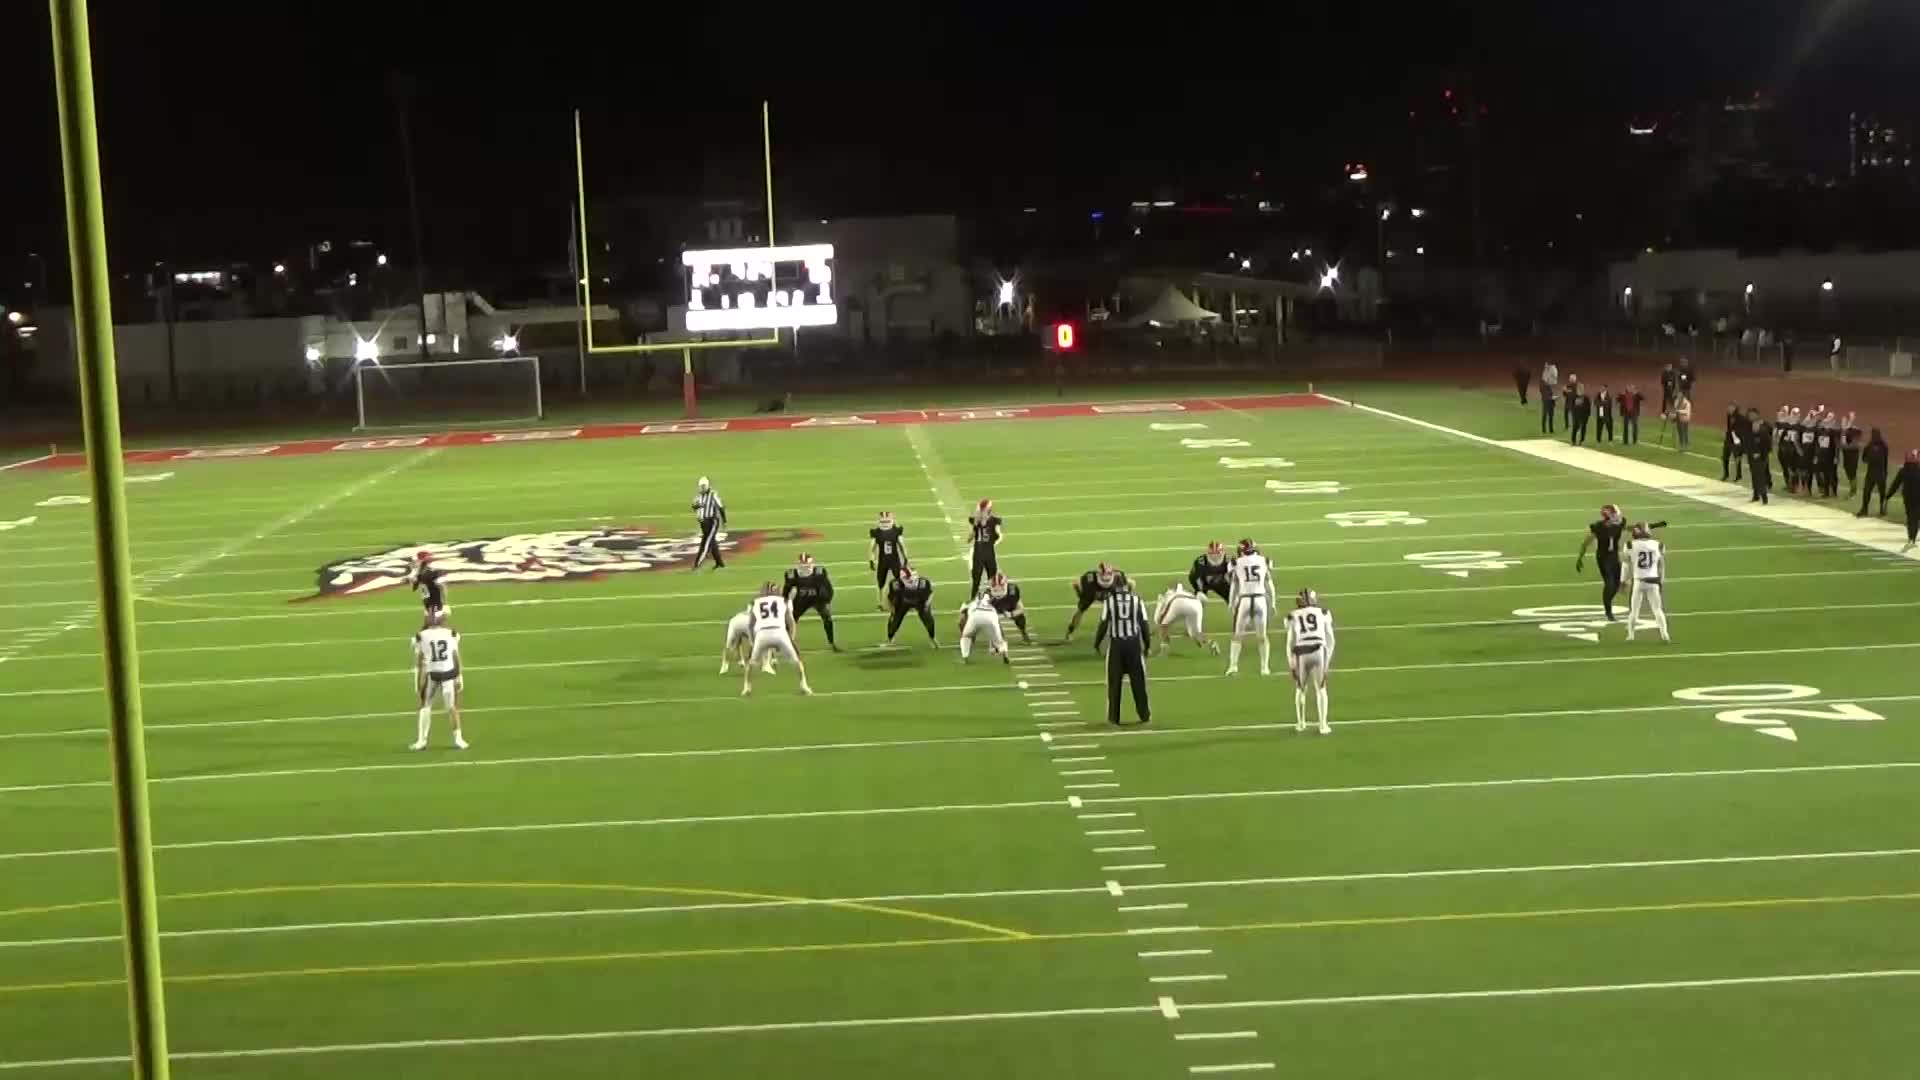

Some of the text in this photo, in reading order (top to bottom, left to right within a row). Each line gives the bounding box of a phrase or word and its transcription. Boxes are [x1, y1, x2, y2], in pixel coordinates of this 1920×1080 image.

[884, 540, 892, 555] 6
[1638, 551, 1653, 570] 21
[1244, 565, 1261, 582] 15
[760, 601, 779, 619] 54
[1298, 613, 1318, 634] 19
[430, 640, 448, 662] 12
